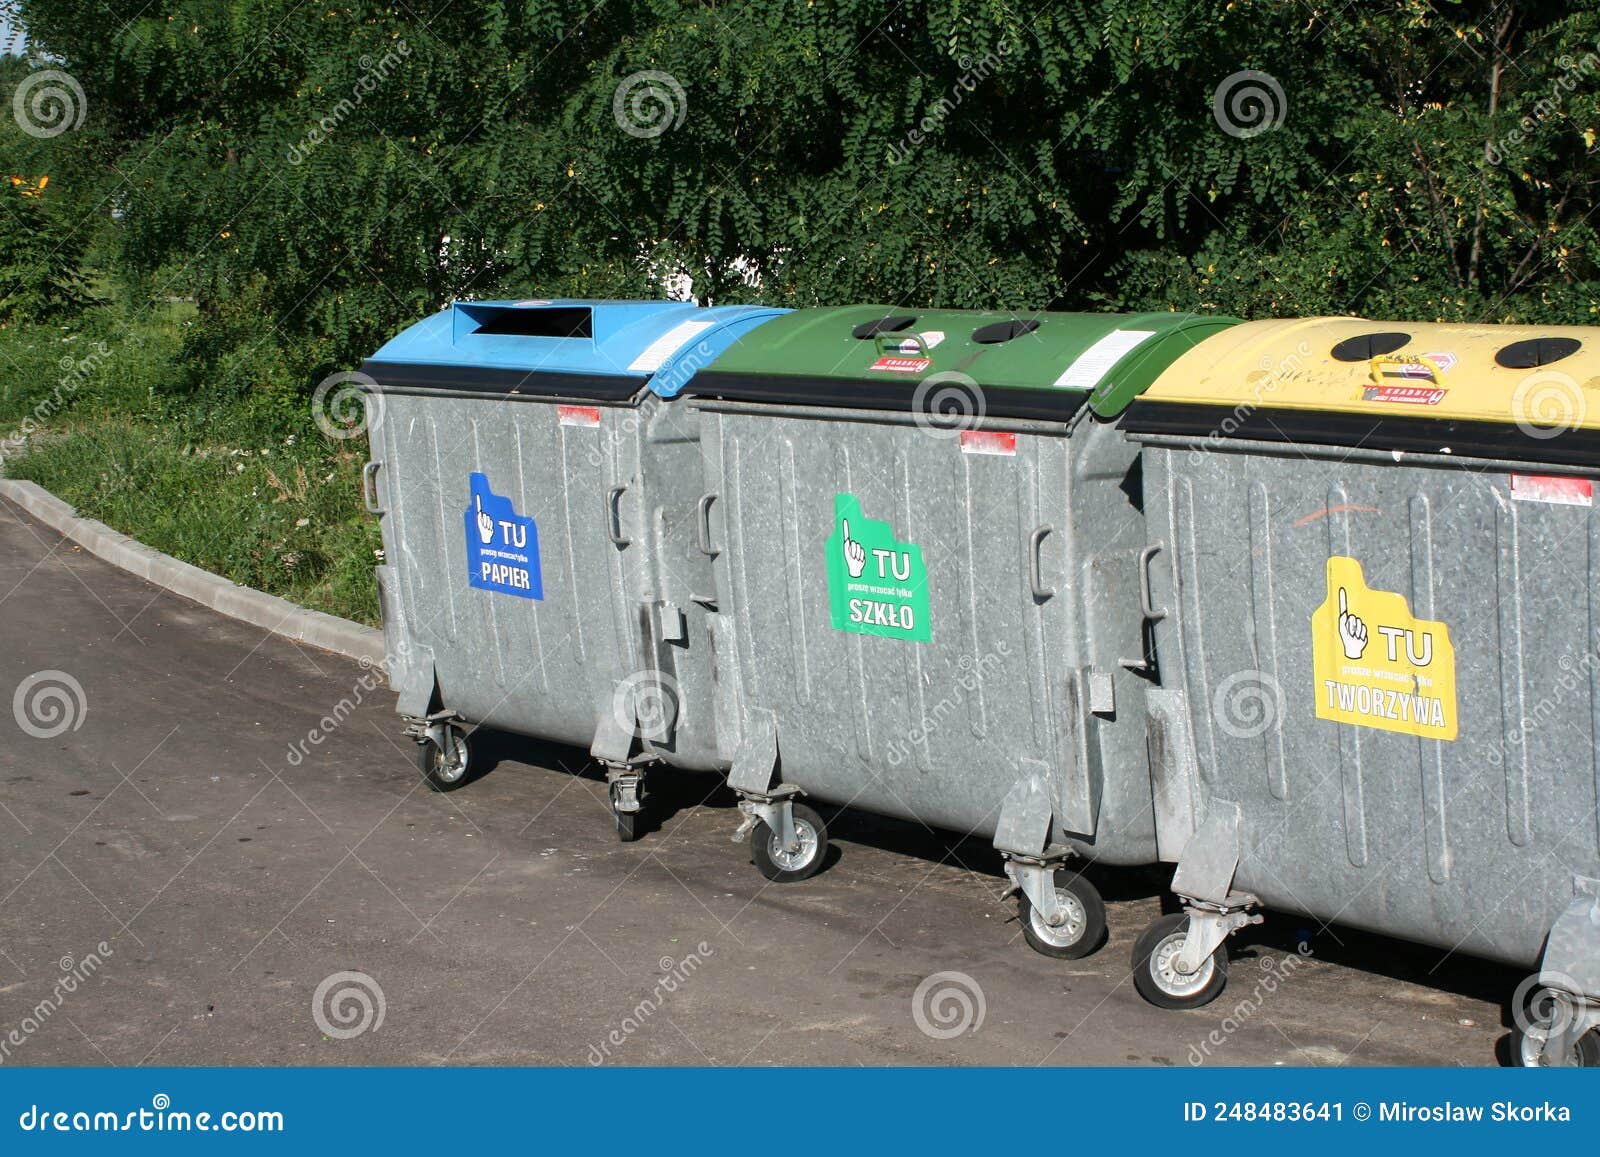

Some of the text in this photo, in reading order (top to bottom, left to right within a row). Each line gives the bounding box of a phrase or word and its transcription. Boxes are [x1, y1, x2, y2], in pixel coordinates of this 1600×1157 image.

[1385, 388, 1432, 397] KRADNIJ
[498, 520, 527, 548] TU
[482, 561, 531, 590] PAPIER
[872, 548, 911, 581] TU
[849, 598, 914, 630] SZKŁO
[1378, 625, 1433, 667] TU
[1325, 680, 1446, 727] TWORZYWA
